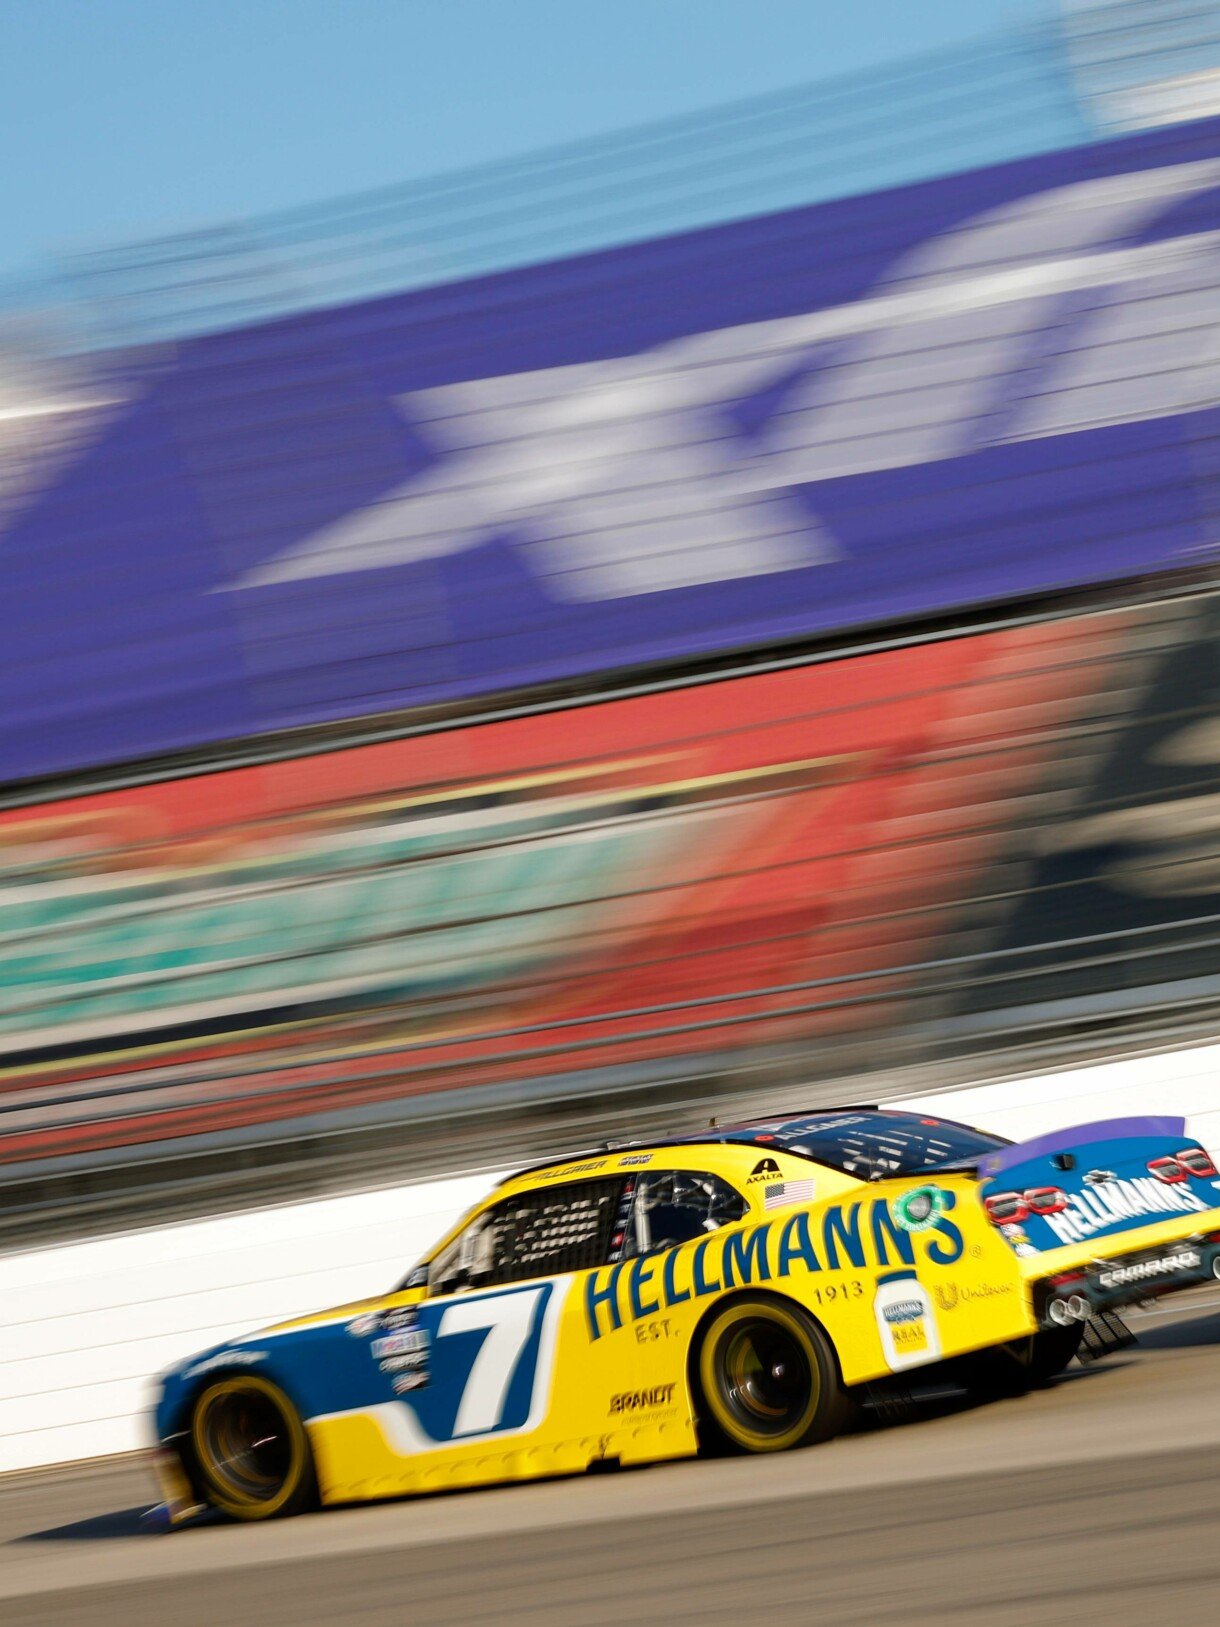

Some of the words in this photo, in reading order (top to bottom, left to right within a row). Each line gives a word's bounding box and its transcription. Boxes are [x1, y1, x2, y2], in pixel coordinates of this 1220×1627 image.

[746, 1172, 783, 1185] AXALTA
[1043, 1178, 1212, 1246] HELLMANNS
[585, 1189, 964, 1343] HELLMANNS
[1099, 1251, 1201, 1288] CAMARO
[814, 1280, 864, 1304] 1913
[635, 1319, 680, 1344] EST.
[437, 1287, 547, 1438] 7
